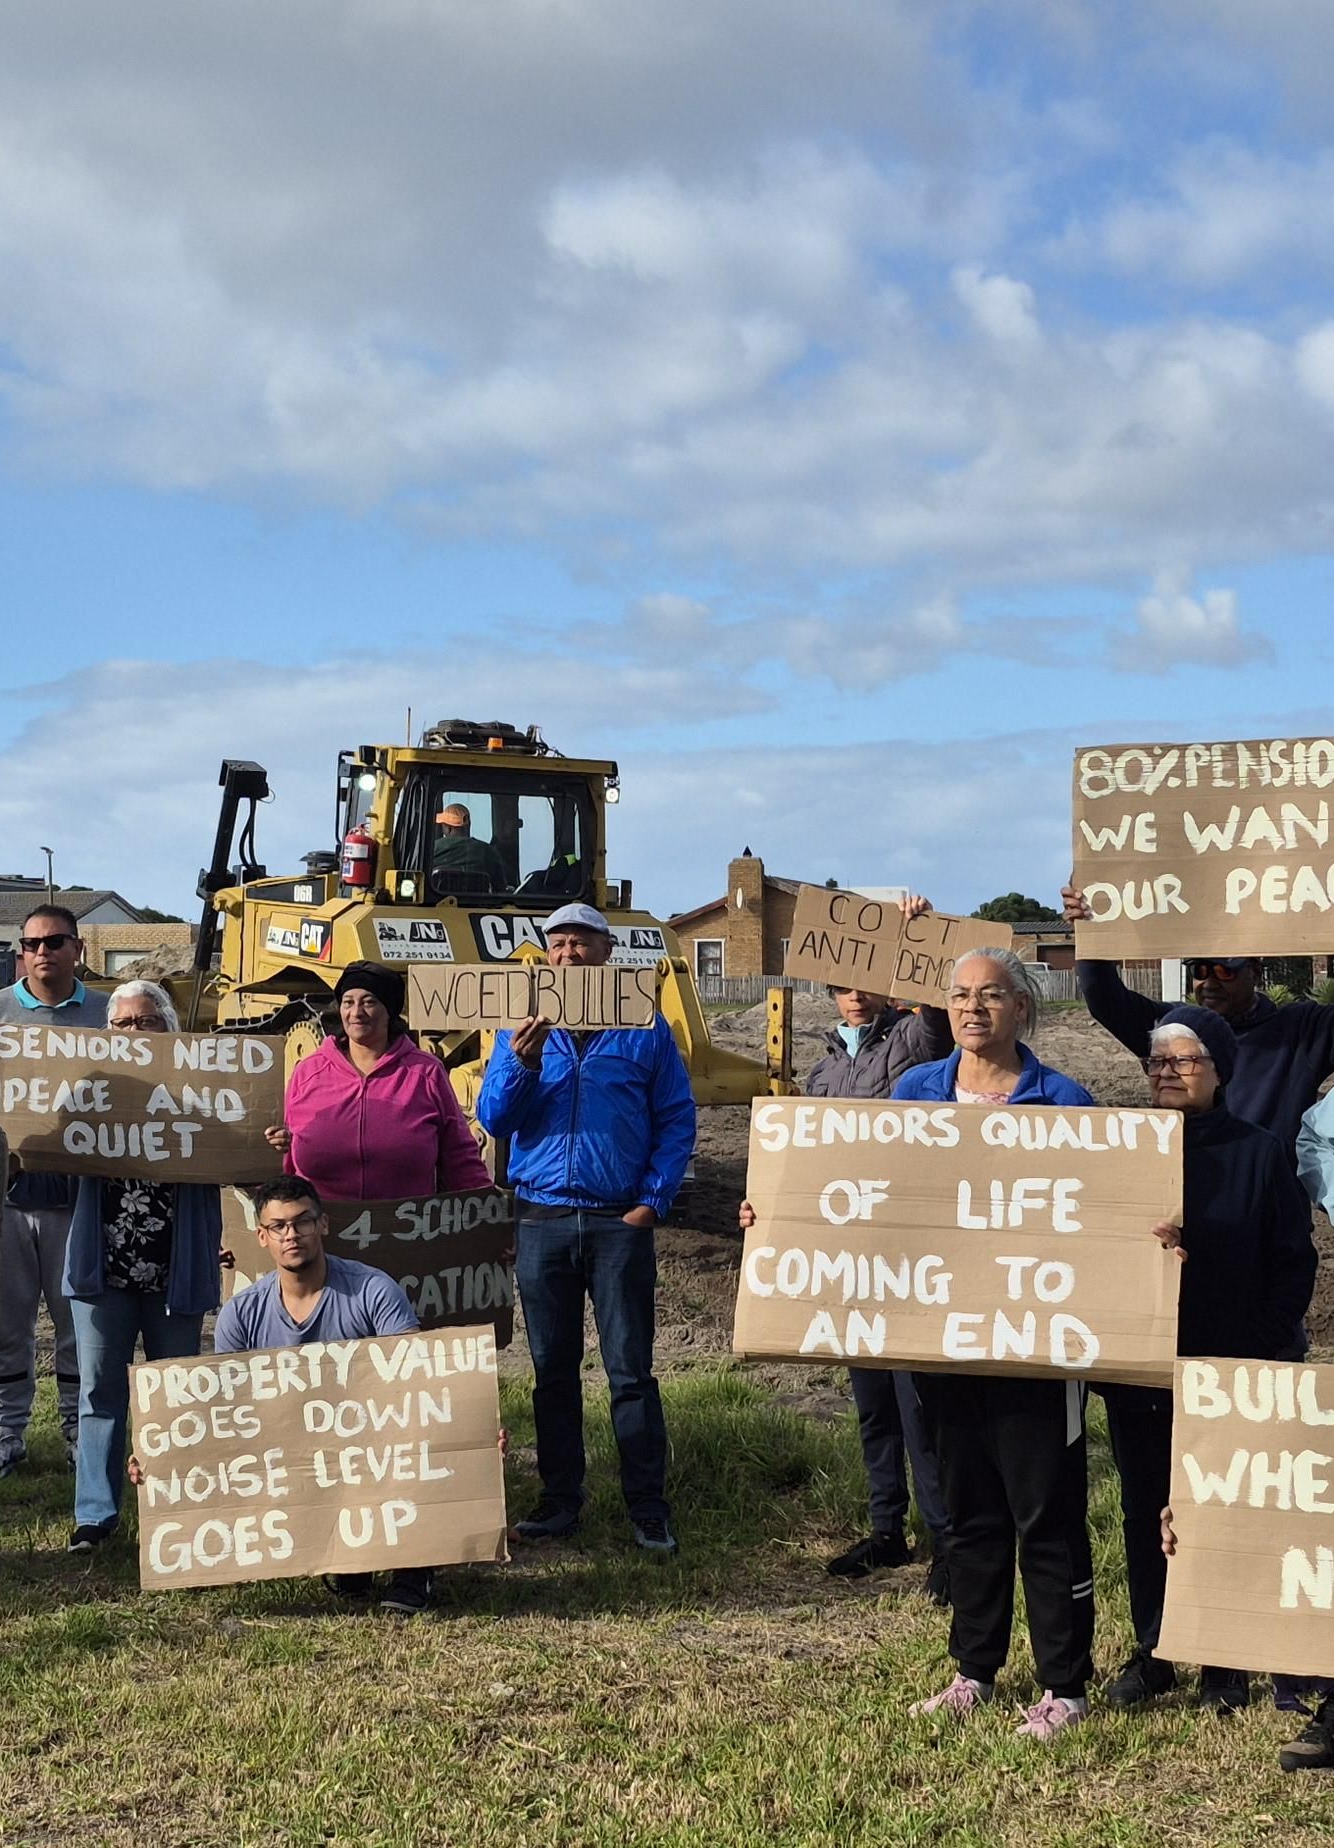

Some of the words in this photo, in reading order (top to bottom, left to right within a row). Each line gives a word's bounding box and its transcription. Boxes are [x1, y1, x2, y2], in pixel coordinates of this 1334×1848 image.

[1079, 811, 1157, 853] WE
[1082, 873, 1190, 922] OUR
[300, 923, 324, 953] CAT
[798, 930, 875, 971] ANTI
[895, 949, 956, 991] DEMO
[413, 970, 531, 1019] WCED
[536, 967, 654, 1026] BULLIES
[173, 1036, 274, 1074] NEED
[3, 1077, 112, 1114] PEACE
[146, 1083, 248, 1122] AND
[63, 1121, 203, 1161] QUIET
[754, 1104, 961, 1151] SENIORS
[980, 1111, 1178, 1154] QUALITY
[338, 1211, 381, 1249] 4
[392, 1194, 513, 1241] SCHOOL
[819, 1179, 891, 1225] OF
[956, 1177, 1084, 1233] LIFE
[744, 1246, 953, 1305] COMING
[995, 1256, 1075, 1303] TO
[798, 1309, 886, 1357] AN
[942, 1309, 1100, 1369] END
[136, 1340, 360, 1413] PROPERTY
[368, 1334, 496, 1384] VALUE
[139, 1405, 262, 1457] GOES
[303, 1387, 452, 1438] DOWN
[146, 1447, 290, 1507] NOISE
[314, 1440, 454, 1489] LEVEL
[149, 1510, 294, 1574] GOES
[339, 1500, 418, 1548] UP
